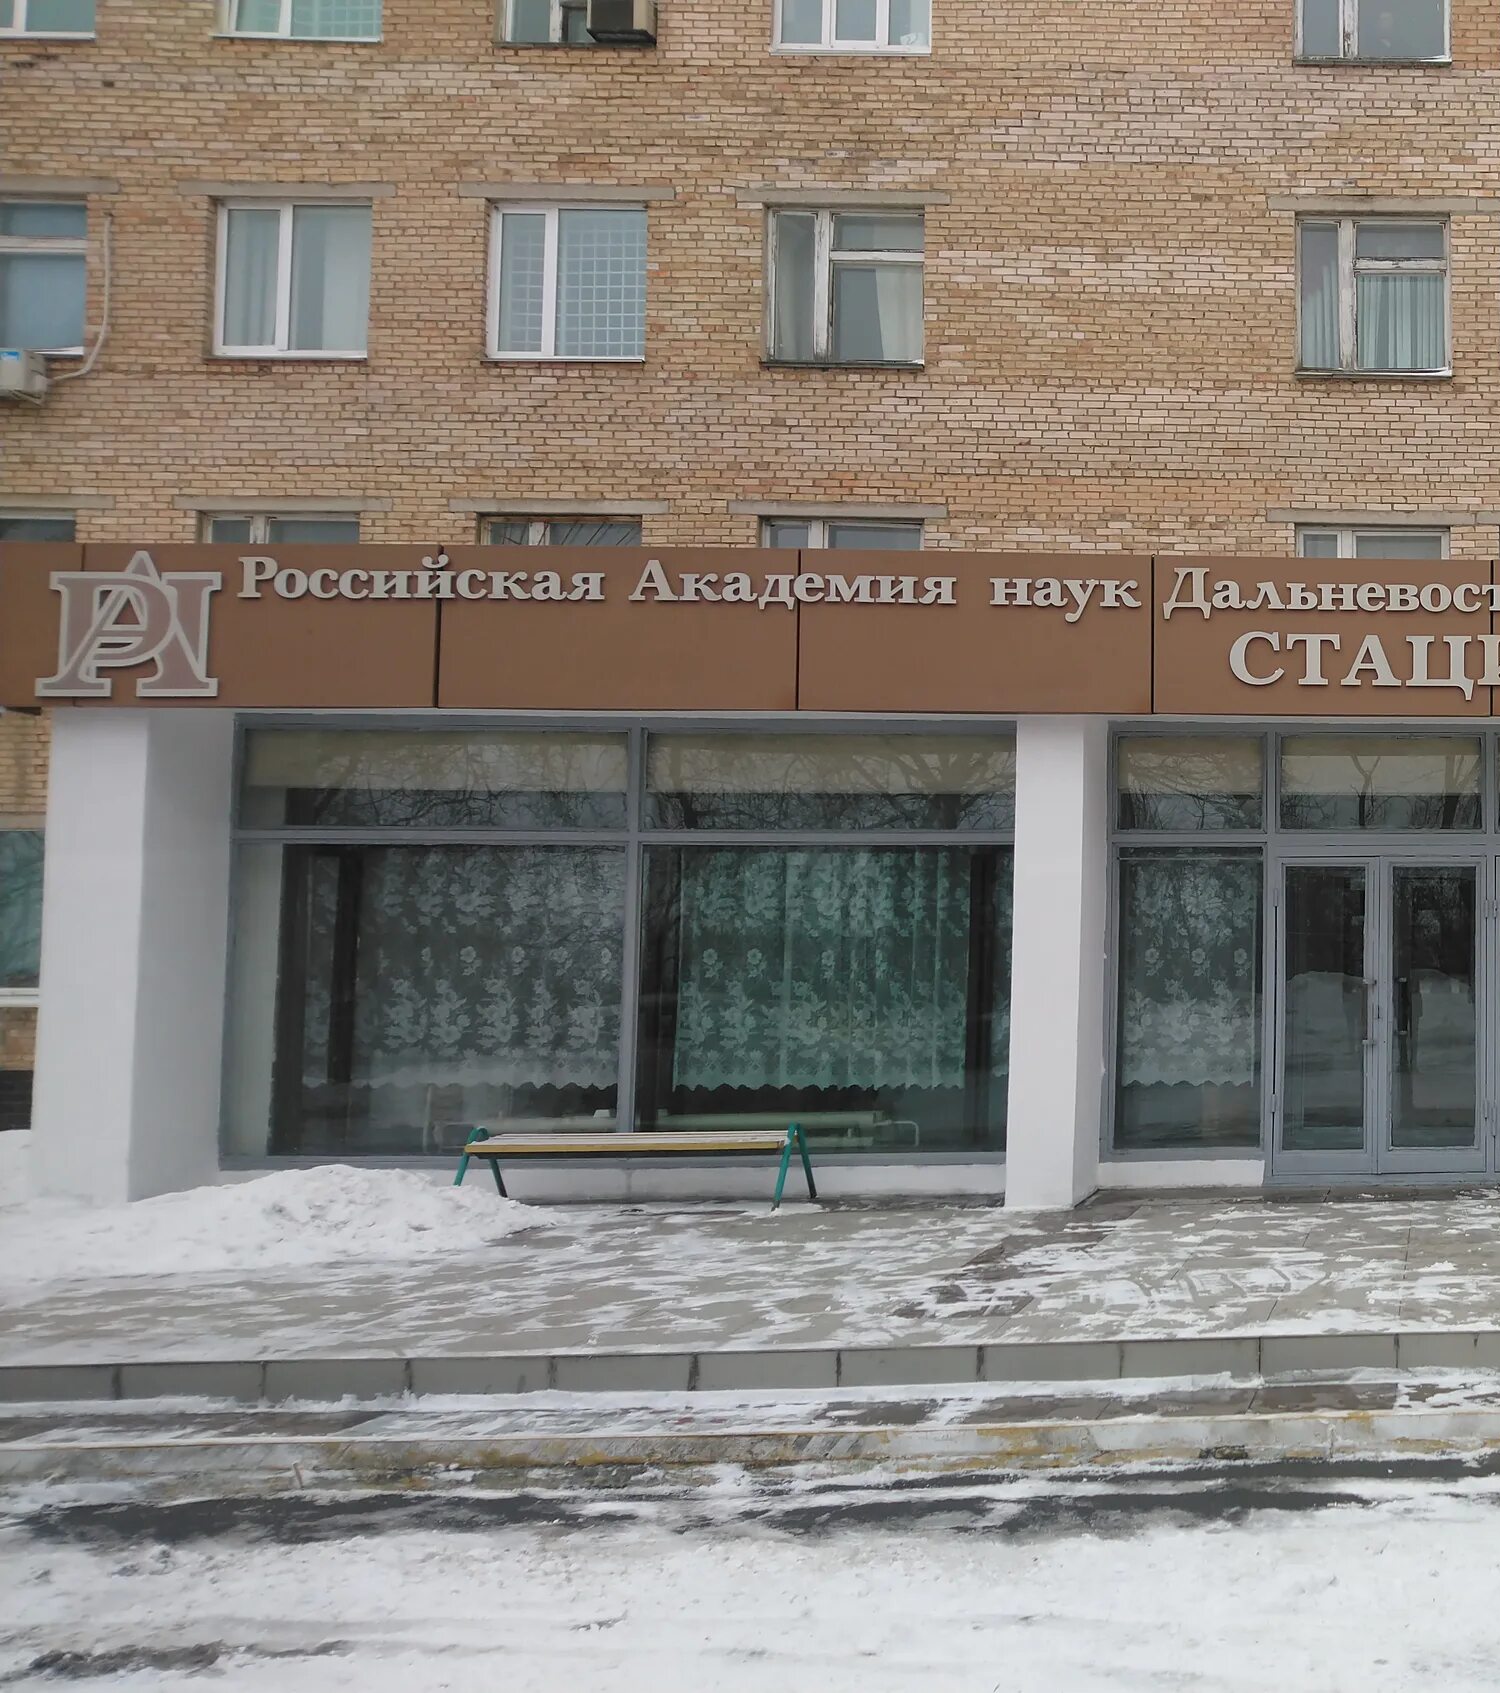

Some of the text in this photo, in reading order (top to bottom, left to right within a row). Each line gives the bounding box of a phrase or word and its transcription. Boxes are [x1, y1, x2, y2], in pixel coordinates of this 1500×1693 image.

[238, 553, 605, 602] Российская
[630, 559, 957, 610] Академия
[990, 577, 1141, 623] наук
